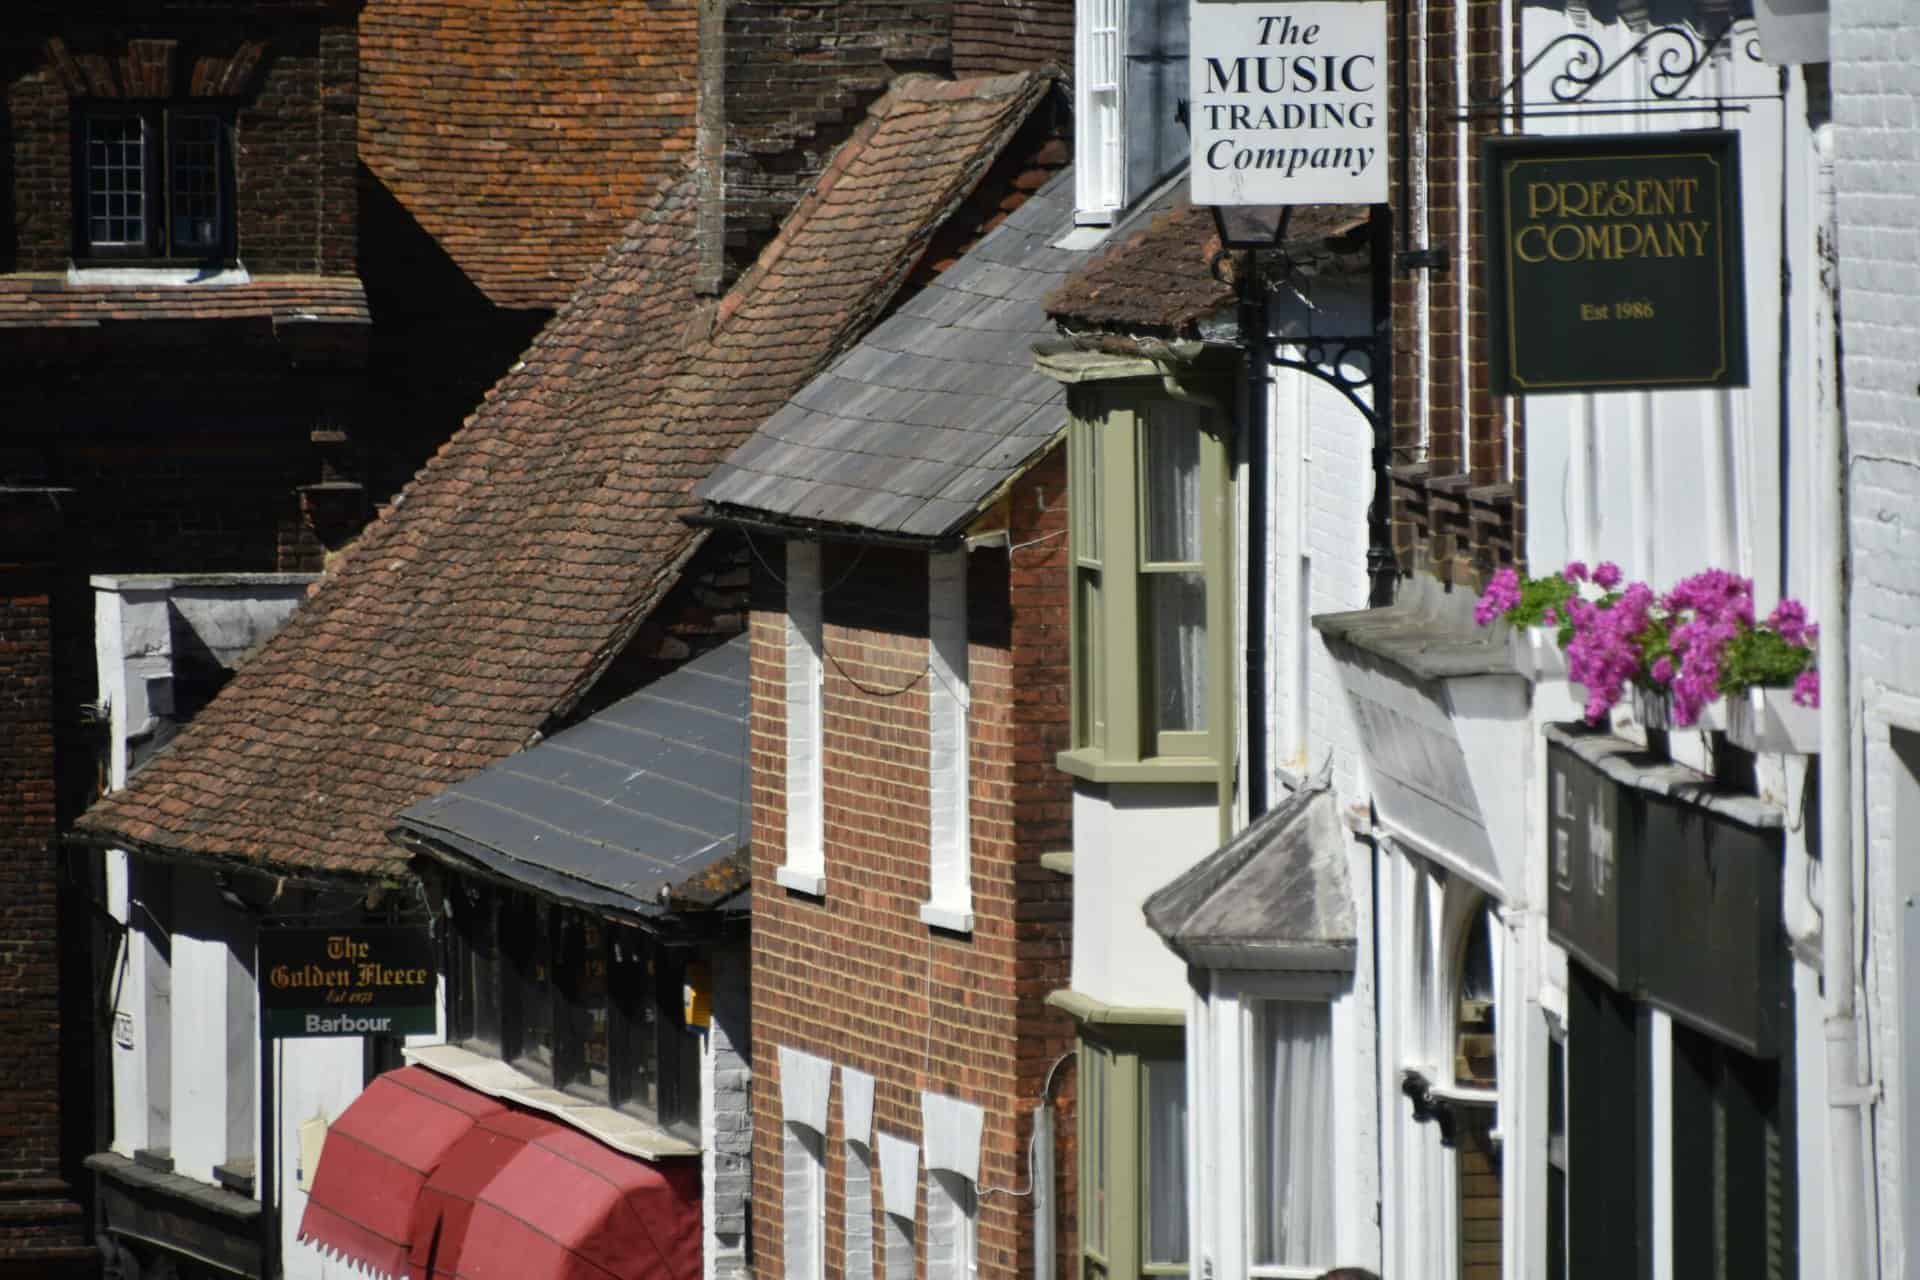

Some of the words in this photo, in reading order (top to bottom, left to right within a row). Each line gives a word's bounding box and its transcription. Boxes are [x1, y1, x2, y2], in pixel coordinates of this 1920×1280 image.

[1256, 15, 1321, 46] The
[1202, 54, 1376, 94] MUSIC
[1203, 102, 1376, 130] TRADING
[1206, 138, 1375, 178] Company
[1527, 175, 1699, 219] PRESENT
[1515, 221, 1712, 263] COMPANY
[1580, 303, 1609, 321] Est
[1615, 301, 1655, 320] 1986
[327, 935, 370, 963] The
[270, 964, 350, 989] Golden
[356, 963, 428, 988] Fleece
[305, 1014, 391, 1033] Barbour
